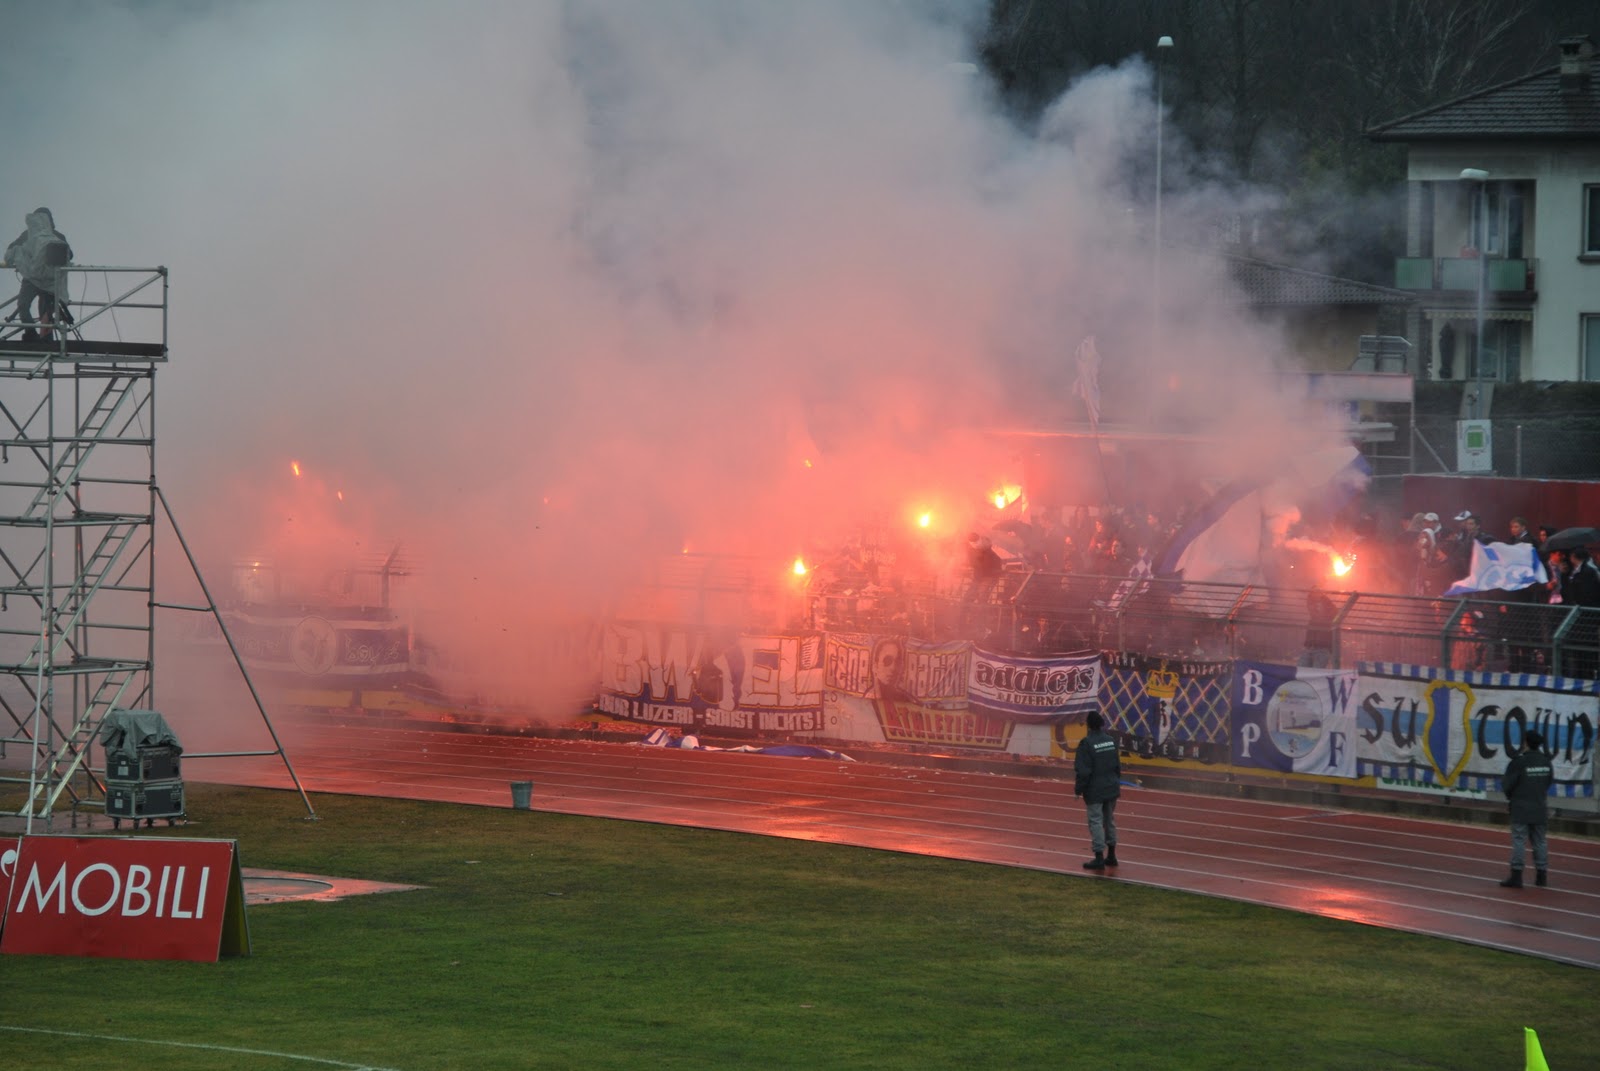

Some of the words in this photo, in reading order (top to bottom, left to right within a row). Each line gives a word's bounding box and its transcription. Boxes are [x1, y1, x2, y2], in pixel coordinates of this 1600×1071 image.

[976, 661, 1094, 695] addicts
[1242, 669, 1264, 705] B
[1326, 676, 1357, 714] W
[599, 694, 630, 717] NUR
[633, 701, 694, 724] LUZERN
[706, 708, 756, 729] SONST
[1007, 693, 1055, 706] LUZERN
[1120, 737, 1200, 758] LUZERN
[1241, 723, 1261, 758] P
[1328, 731, 1346, 767] F
[16, 861, 210, 919] MOBILI
